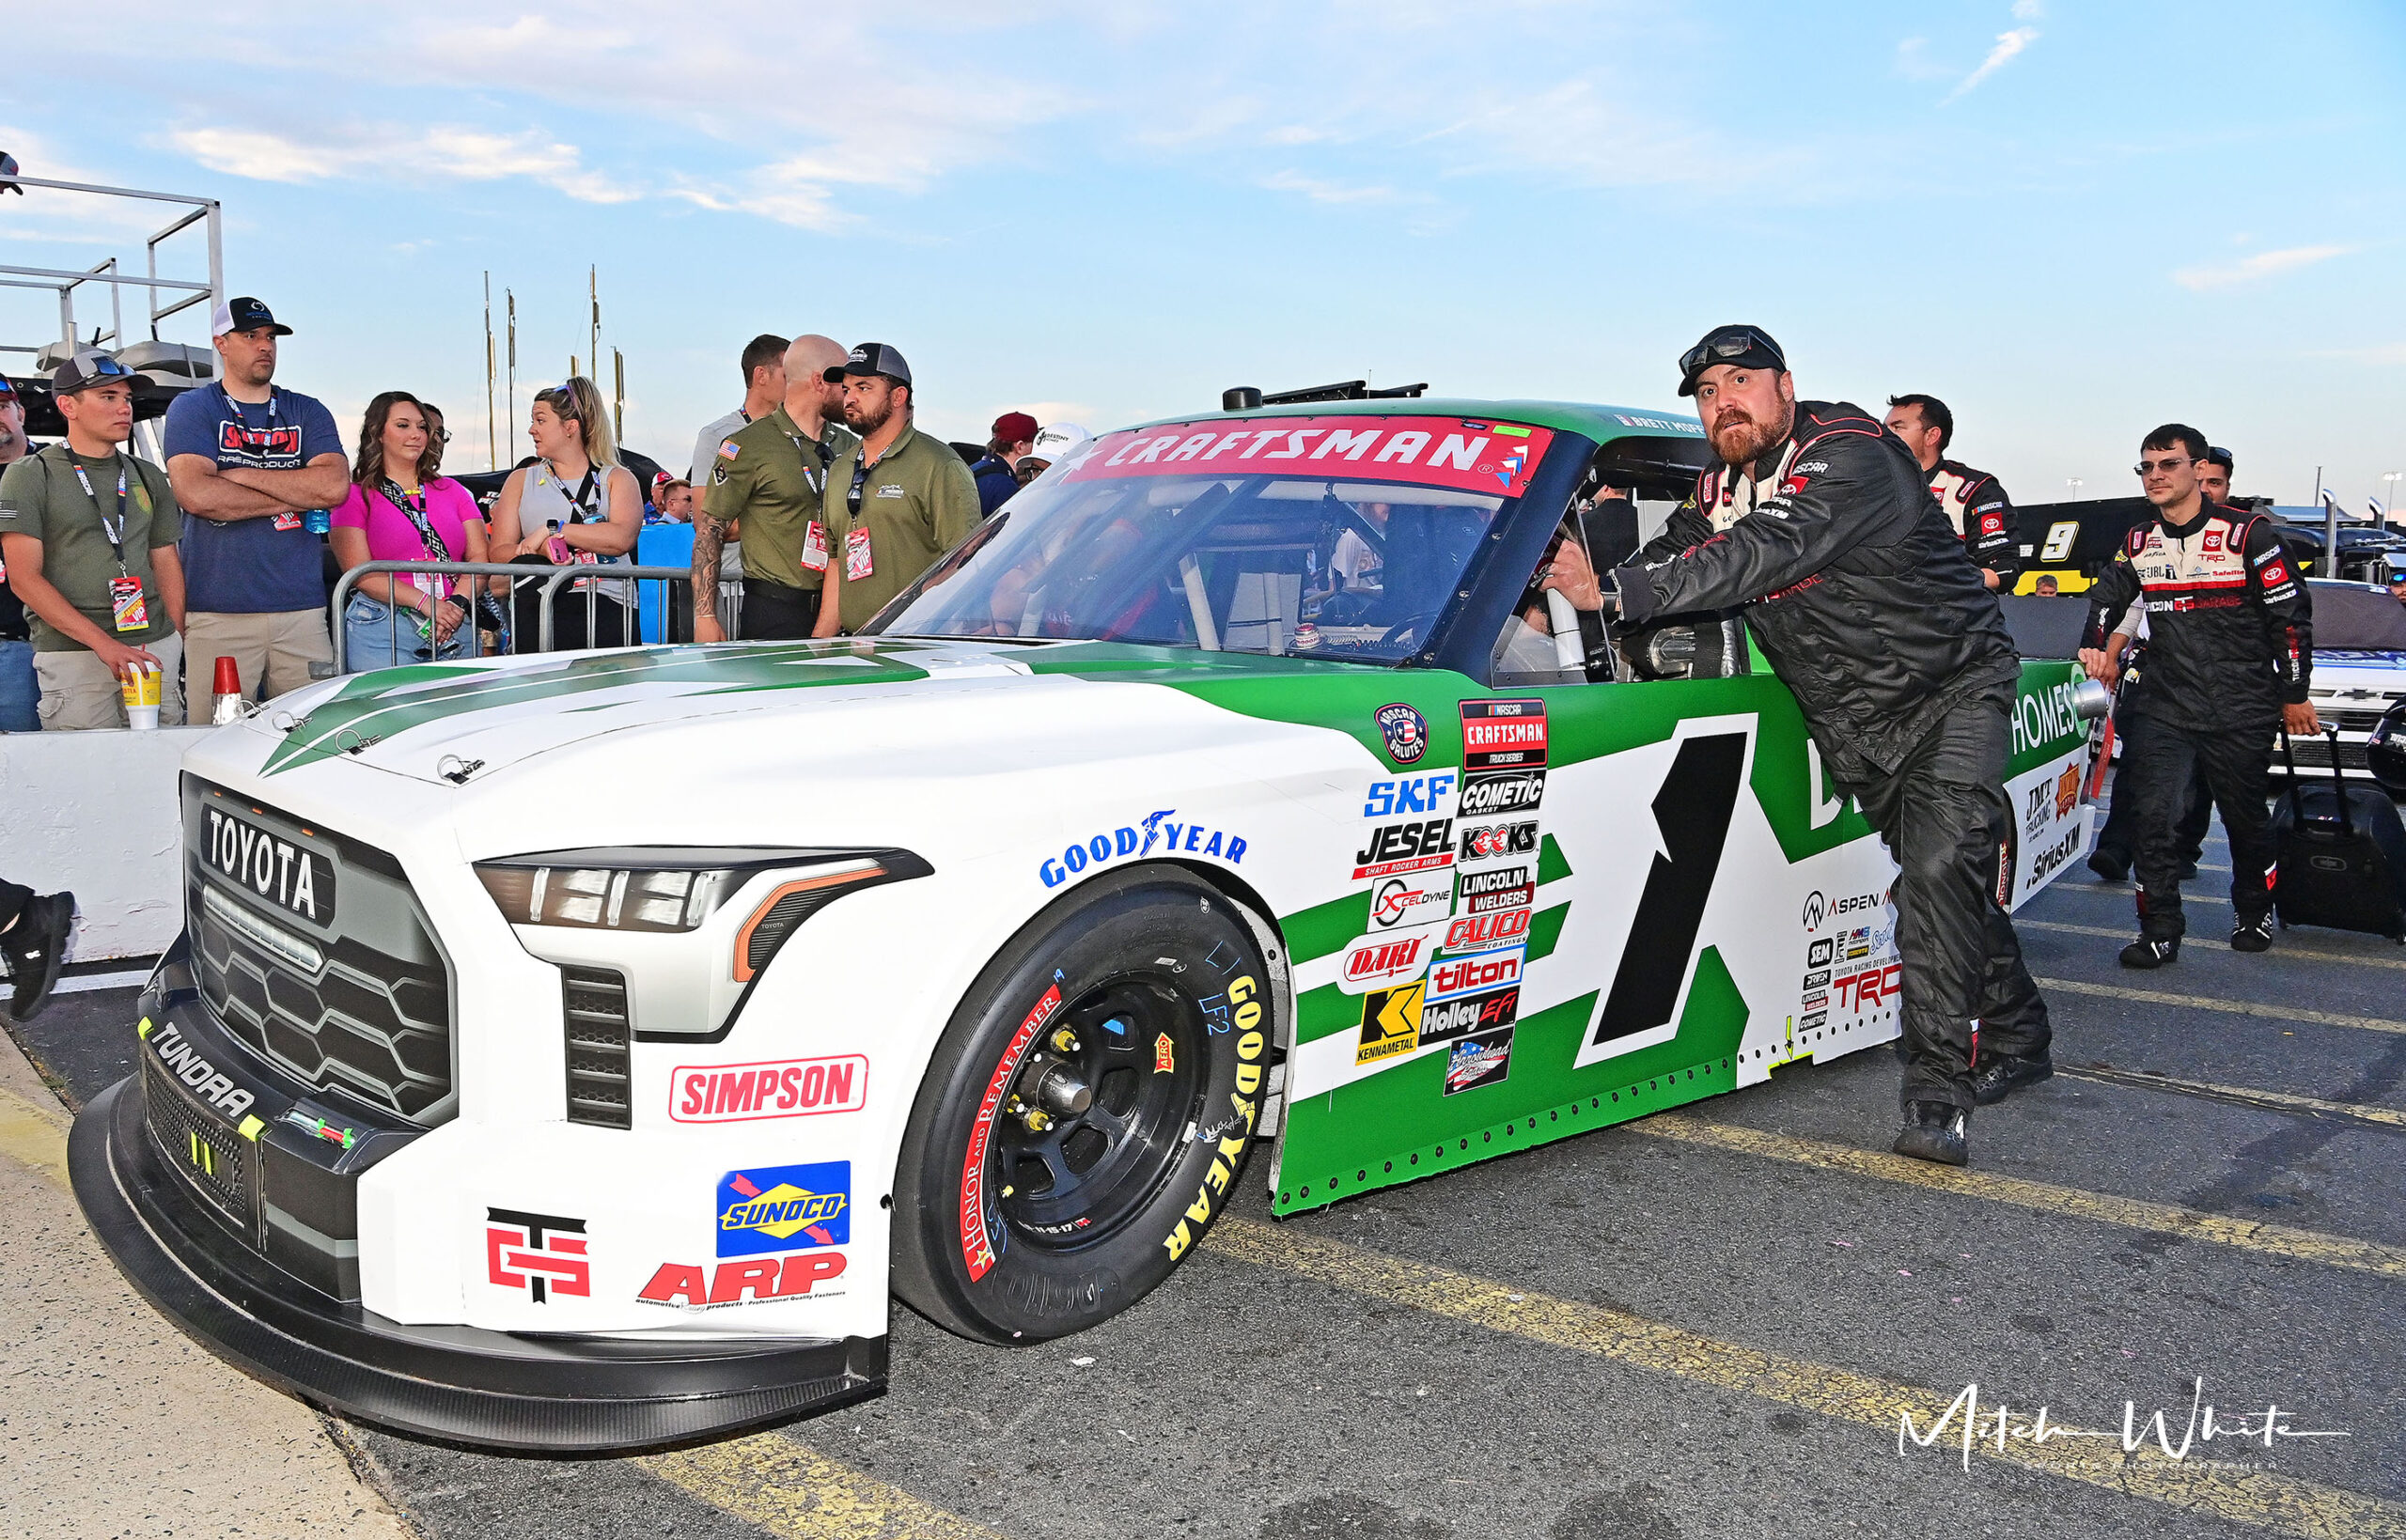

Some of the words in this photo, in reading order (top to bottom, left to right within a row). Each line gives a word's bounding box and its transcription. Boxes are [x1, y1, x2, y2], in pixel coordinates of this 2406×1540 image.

[1631, 416, 1672, 430] BRETT
[1671, 421, 1705, 434] MOFF
[1105, 428, 1490, 472] CRAFTSMAN
[2040, 521, 2080, 563] 9
[856, 550, 871, 570] VIP
[2147, 566, 2165, 579] JBL
[2197, 553, 2226, 564] TRD
[132, 606, 145, 621] VIP
[1380, 708, 1416, 727] NASCAR
[1496, 705, 1523, 716] NASCAR
[2010, 681, 2075, 755] HOMES
[1389, 737, 1424, 758] SALUTES
[1467, 723, 1544, 745] CRAFTSMAN
[1489, 754, 1505, 764] TRUCK
[1505, 752, 1523, 763] SERIES
[1364, 774, 1455, 817] SKF
[1461, 778, 1543, 810] COMETIC
[2026, 778, 2053, 822] JMT
[1466, 806, 1498, 816] GASKET
[1356, 817, 1457, 865] JESEL
[1459, 820, 1539, 863] KOOKS
[2031, 822, 2081, 886] SiriusXM
[209, 810, 318, 920] TOYOTA
[1365, 865, 1388, 877] SHAFT
[1391, 861, 1420, 872] ROCKER
[1421, 857, 1443, 867] ARMS
[1462, 868, 1525, 895] LINCOLN
[1584, 723, 1754, 1057] 1
[1372, 889, 1450, 917] XCELDYNE
[1474, 890, 1529, 912] WELDERS
[1827, 893, 1880, 917] ASPEN
[1445, 908, 1532, 949] CALICO
[1349, 935, 1428, 976] DART
[1487, 936, 1526, 950] COATINGS
[1810, 942, 1831, 964] SEM
[1433, 958, 1518, 992] tilton
[1835, 965, 1853, 978] TOYOTA
[1853, 960, 1872, 972] RACING
[1872, 954, 1902, 969] DEVELOPME
[1803, 990, 1826, 1003] LINCOLN
[1420, 1002, 1481, 1035] Holley
[1479, 991, 1518, 1022] EFI
[1800, 1012, 1826, 1030] COMETIC
[977, 994, 1059, 1124] REMEMBER
[1160, 1040, 1169, 1066] AERO
[1357, 1037, 1414, 1062] KENNAMETAL
[1449, 1038, 1512, 1069] Arrowhead
[151, 1021, 256, 1119] TUNDRA
[681, 1063, 854, 1115] SIMPSON
[975, 1127, 986, 1156] AND
[726, 1195, 843, 1228] SUNOCO
[964, 1162, 983, 1253] HONOR
[637, 1252, 848, 1305] ARP
[635, 1299, 680, 1309] automotive
[706, 1301, 743, 1311] products
[748, 1296, 790, 1306] Professional
[789, 1294, 813, 1302] Quality
[814, 1291, 847, 1299] Fasteners
